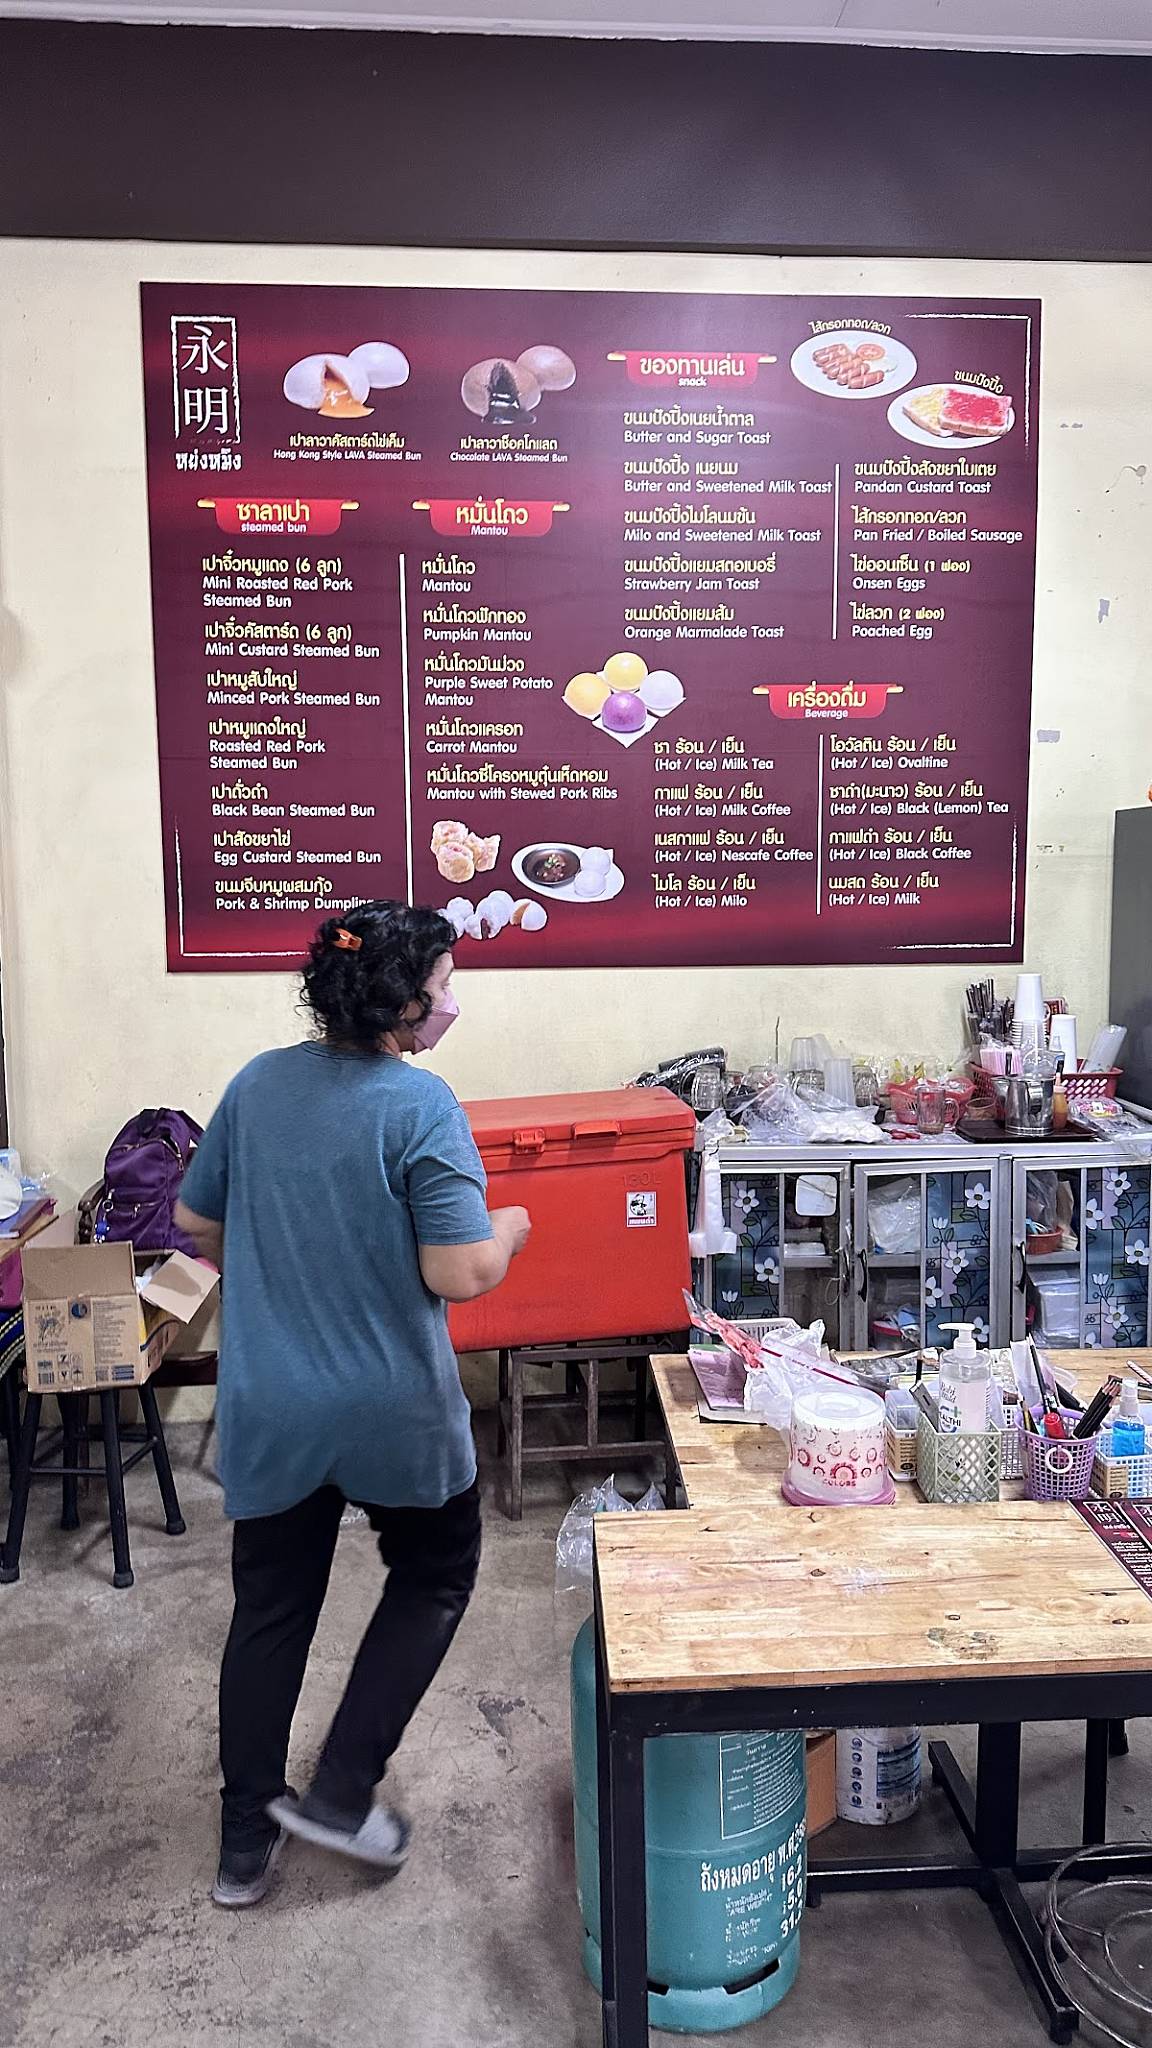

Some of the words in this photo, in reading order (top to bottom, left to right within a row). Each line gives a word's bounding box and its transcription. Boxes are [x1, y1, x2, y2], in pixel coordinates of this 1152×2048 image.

[808, 319, 891, 335] ไส้กรอกทอด/ลวก
[640, 353, 745, 376] ของทานเล่น
[181, 325, 229, 434] 永明
[678, 376, 707, 386] snack
[624, 430, 663, 443] Butter
[696, 431, 734, 446] Sugar
[737, 432, 771, 444] Toast
[274, 449, 296, 460] Hong
[299, 450, 320, 461] Kong
[322, 450, 342, 461] Style
[344, 450, 365, 459] LAVA
[367, 451, 402, 460] Steamed
[405, 451, 421, 460] Bun
[450, 452, 490, 461] Chocolate
[492, 452, 513, 462] LAVA
[514, 453, 549, 462] Steamed
[552, 453, 568, 462] Bun
[624, 453, 690, 475] ขนมปังปิ้ง
[696, 462, 738, 475] เนยนม
[625, 480, 663, 492] Butter
[696, 480, 764, 493] Sweetened
[768, 480, 795, 493] Milk
[799, 481, 832, 493] Toast
[855, 480, 902, 493] Pandan
[907, 481, 954, 493] Custard
[958, 481, 991, 493] Toast
[236, 499, 310, 521] ซาลาเปา
[457, 496, 528, 524] หมั่นโถว
[850, 505, 966, 524] ไส้กรอกทอด/ลวก
[241, 522, 284, 532] steamed
[287, 521, 306, 532] bun
[471, 525, 508, 535] Mantou
[624, 528, 651, 541] Milo
[685, 529, 753, 541] Sweetened
[757, 529, 784, 541] Milk
[787, 529, 821, 541] Toast
[854, 529, 878, 541] Pan
[883, 528, 913, 541] Fried
[928, 528, 966, 541] Boiled
[971, 529, 1023, 544] Sausage
[202, 549, 289, 576] เปาจิ๋วหมูแดง
[317, 557, 341, 577] ลูก)
[422, 553, 475, 574] หมั่นโถว
[849, 553, 919, 572] ไข่ออนเซ็น
[941, 559, 970, 573] ฟอง)
[203, 576, 231, 589] Mini
[236, 577, 288, 590] Roasted
[293, 577, 318, 590] Red
[323, 578, 353, 591] Pork
[422, 579, 471, 592] Mantou
[624, 577, 692, 592] Strawberry
[695, 578, 722, 590] Jam
[726, 578, 760, 590] Toast
[853, 577, 892, 589] Onsen
[897, 577, 925, 592] Eggs
[203, 593, 261, 607] Steamed
[266, 594, 292, 607] Bun
[423, 602, 526, 624] หมั่นโถวฟักทอง
[849, 601, 892, 620] ไข่ลวก
[915, 607, 944, 620] ฟอง)
[327, 624, 351, 644] ลูก)
[424, 628, 478, 643] Pumpkin
[483, 629, 531, 641] Mantou
[625, 626, 671, 641] Orange
[676, 625, 747, 638] Marmalade
[751, 626, 784, 638] Toast
[852, 624, 905, 637] Poached
[910, 625, 932, 640] Egg
[205, 642, 233, 655] Mini
[239, 643, 288, 656] Custard
[293, 644, 349, 657] Steamed
[355, 645, 379, 657] Bun
[207, 667, 297, 691] เปาหมูสับใหญ่
[425, 676, 466, 691] Purple
[470, 676, 508, 689] Sweet
[513, 677, 553, 689] Potato
[207, 691, 255, 704] Minced
[260, 691, 289, 704] Pork
[294, 692, 350, 705] Steamed
[356, 693, 380, 705] Bun
[425, 693, 473, 706] Mantou
[788, 680, 866, 707] เครื่องดื่ม
[805, 708, 848, 719] Beverage
[209, 716, 306, 739] เปาหมูแดงใหญ่
[426, 715, 523, 736] หมั่นโถวแครอท
[210, 739, 261, 752] Roasted
[267, 739, 291, 752] Red
[296, 739, 326, 753] Pork
[426, 740, 466, 753] Carrot
[469, 741, 517, 753] Mantou
[654, 742, 670, 754] ชา
[830, 734, 882, 752] โอวัลติน
[210, 756, 267, 769] Steamed
[272, 757, 297, 769] Bun
[722, 757, 748, 769] Milk
[752, 758, 773, 769] Tea
[898, 756, 948, 768] Ovaltine
[212, 778, 268, 799] เปาถั่วดำ
[427, 787, 475, 799] Mantou
[479, 787, 506, 799] with
[510, 787, 555, 799] Stewed
[560, 787, 588, 799] Pork
[592, 786, 617, 799] Ribs
[655, 784, 688, 800] กาแฟ
[829, 782, 908, 800] ชาดำ(มะนาว)
[212, 803, 247, 816] Black
[252, 804, 284, 816] Bean
[290, 804, 345, 816] Steamed
[350, 804, 375, 816] Bun
[721, 803, 748, 816] Milk
[752, 803, 791, 815] Coffee
[897, 802, 929, 814] Black
[934, 801, 982, 815] (Lemon)
[987, 802, 1008, 812] Tea
[214, 828, 290, 846] เปาสังขยาไข่
[655, 830, 710, 846] เนสกาแฟ
[829, 828, 879, 844] กาแฟดำ
[214, 851, 237, 866] Egg
[243, 850, 291, 863] Custard
[296, 851, 352, 863] Steamed
[357, 851, 381, 863] Bun
[722, 849, 770, 861] Nescafe
[774, 849, 813, 861] Coffee
[896, 847, 928, 859] Black
[932, 847, 972, 859] Coffee
[651, 873, 682, 891] ไมโล
[829, 877, 865, 889] นมสด
[216, 897, 245, 910] Pork
[264, 897, 309, 912] Shrimp
[315, 897, 374, 911] Dumplin
[721, 894, 747, 906] Milo
[700, 1848, 775, 1892] ถังหมดอายุ
